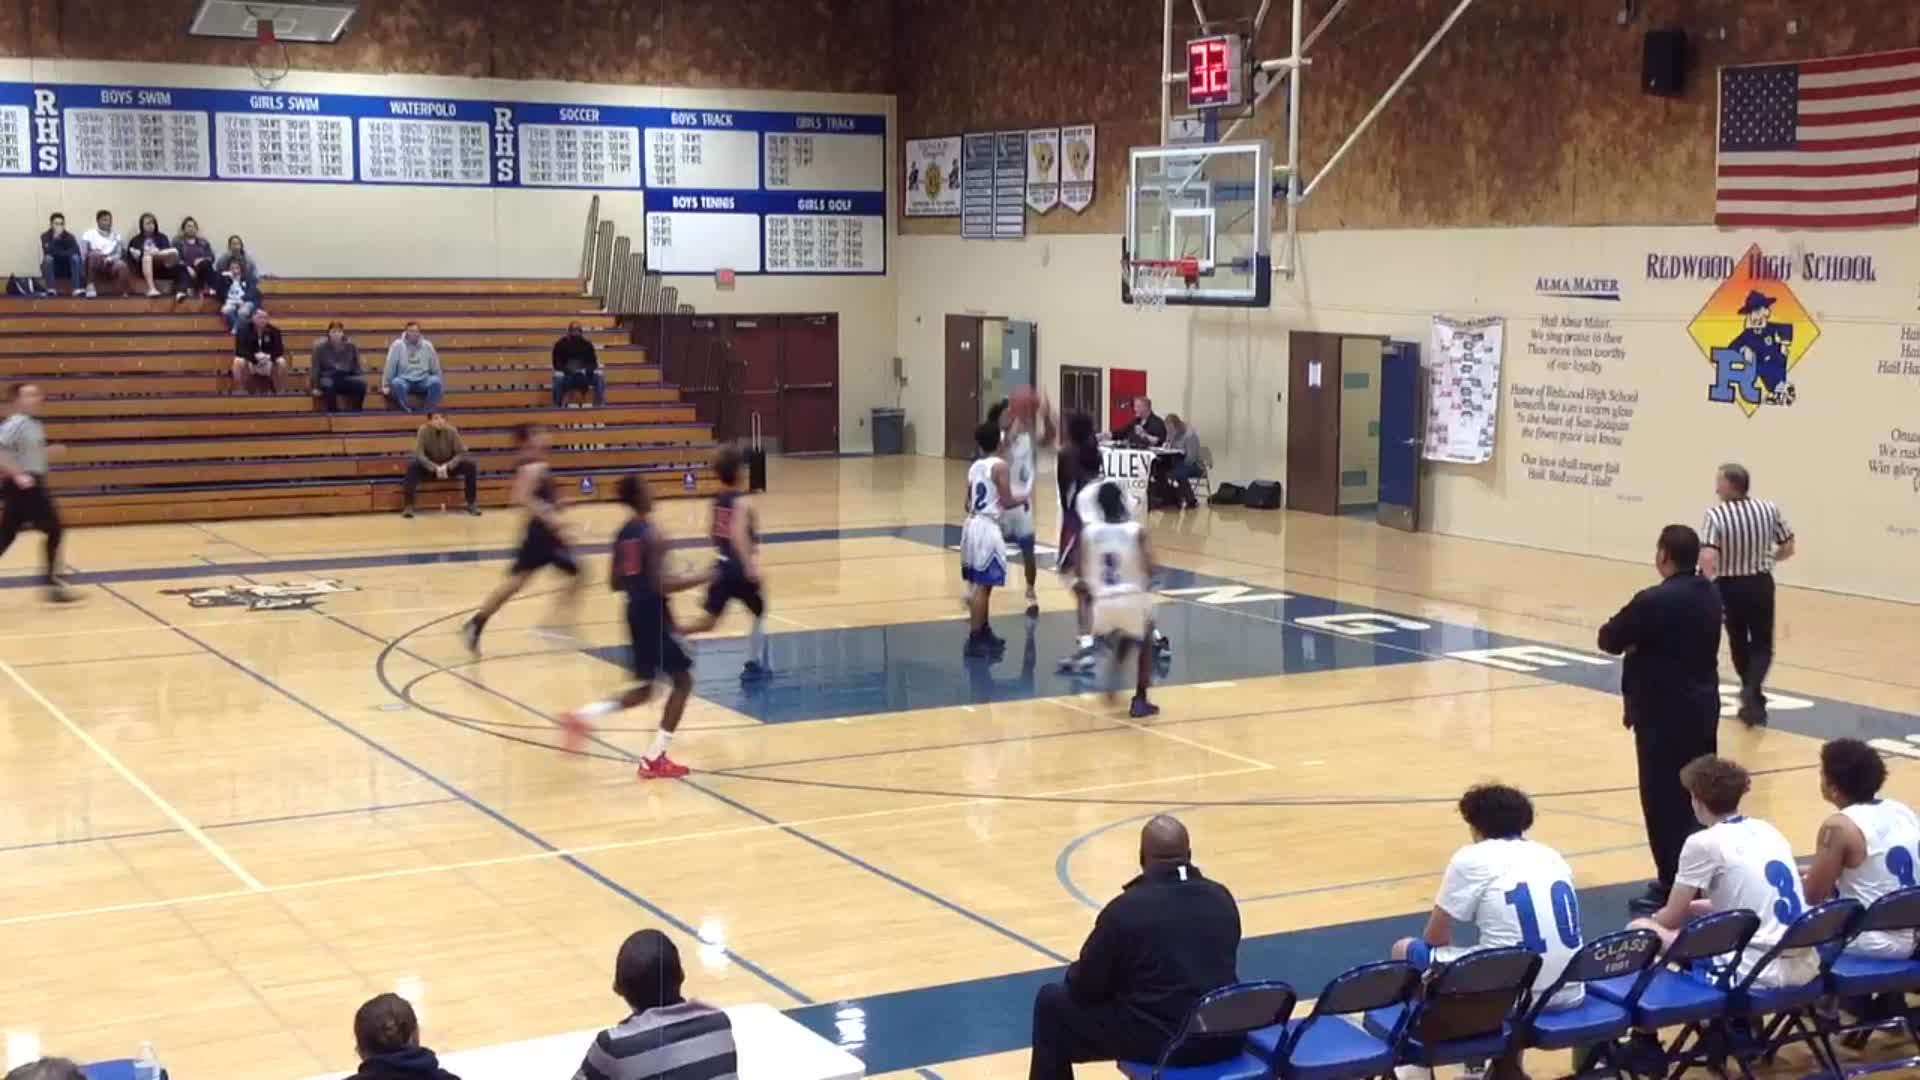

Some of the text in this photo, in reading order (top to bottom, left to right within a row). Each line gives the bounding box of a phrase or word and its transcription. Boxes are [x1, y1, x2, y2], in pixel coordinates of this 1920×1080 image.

[1190, 42, 1227, 94] 32
[101, 89, 172, 106] BOYS SWIM
[249, 95, 320, 112] GIRLS SWIM
[390, 100, 457, 117] WATERPOLO
[560, 107, 600, 122] SOCCER
[671, 111, 733, 127] BOYS TRACK
[827, 117, 856, 130] TRACK
[34, 88, 60, 172] RHS
[494, 107, 515, 182] RHS
[672, 195, 735, 210] BOYS TENNIS
[797, 198, 852, 212] GIRLS GOLF
[1646, 253, 1735, 280] REDWOOD
[1802, 252, 1877, 282] SCHOOL
[974, 481, 988, 511] 2
[1764, 859, 1803, 926] 3
[1503, 879, 1580, 954] 10
[1593, 938, 1649, 961] CLASS
